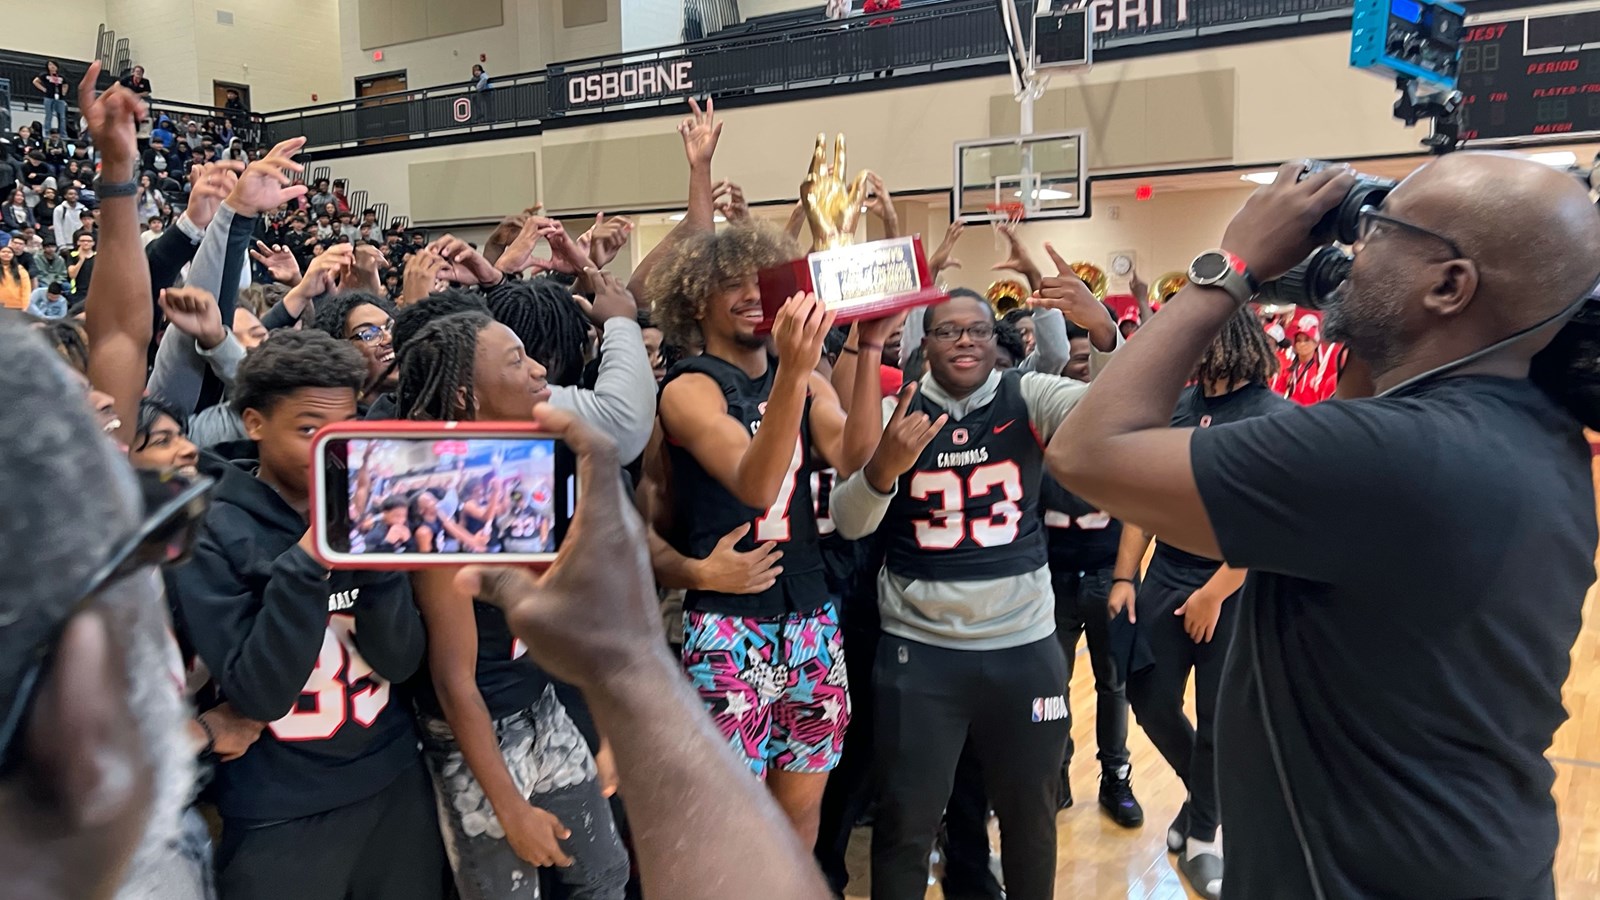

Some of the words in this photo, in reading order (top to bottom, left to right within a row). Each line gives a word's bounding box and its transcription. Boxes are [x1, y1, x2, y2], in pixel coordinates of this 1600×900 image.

[1527, 60, 1579, 74] PERIOD
[567, 61, 693, 104] OSBORNE
[453, 97, 471, 122] O
[937, 446, 989, 468] CARDINALS
[909, 459, 1024, 551] 33
[1043, 694, 1069, 722] NBA
